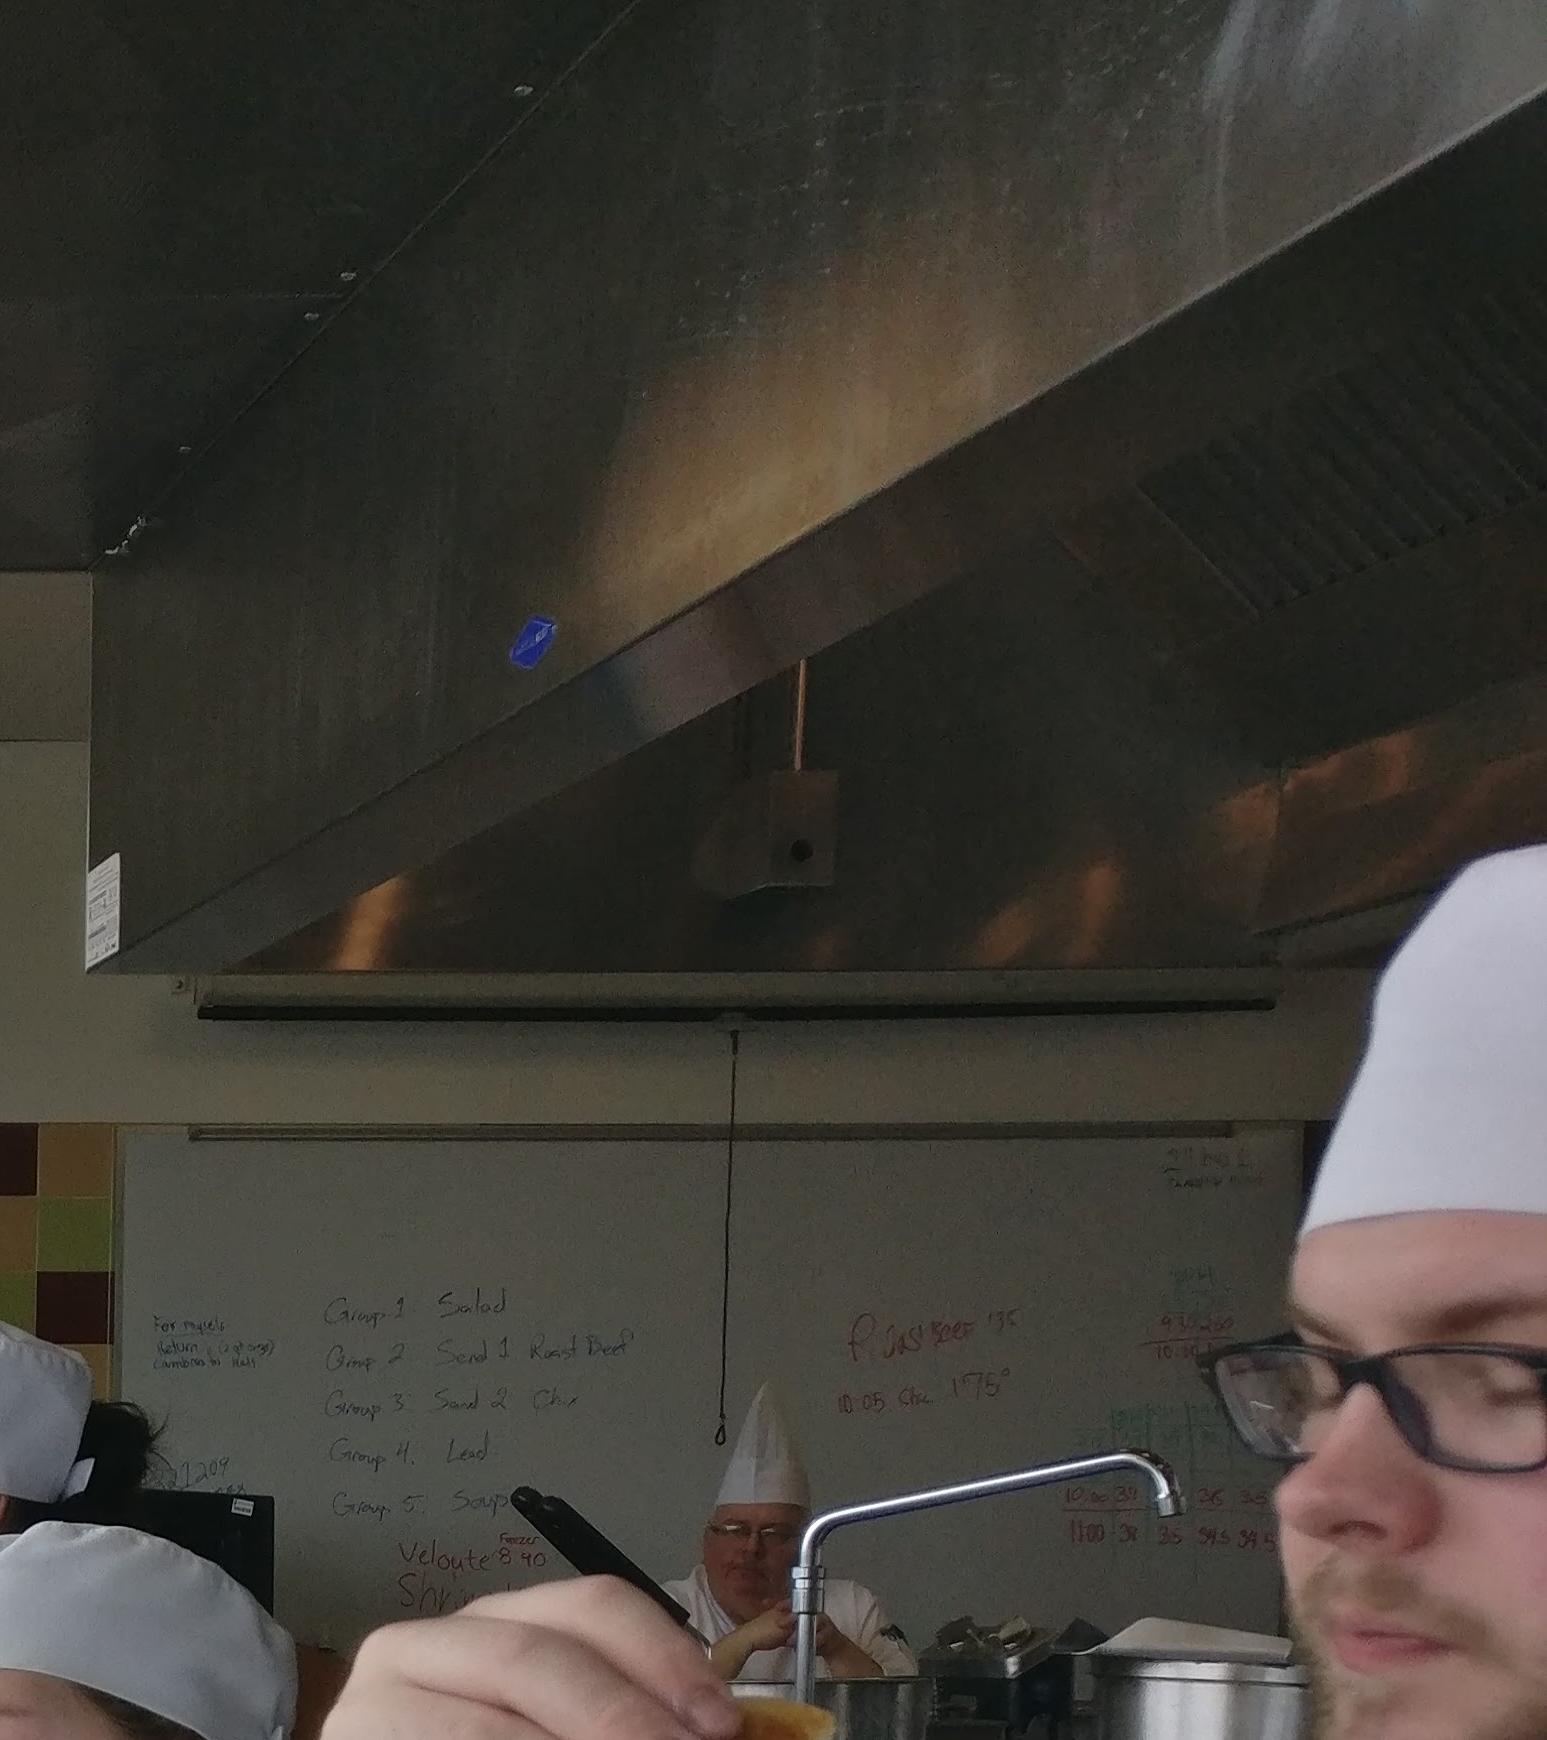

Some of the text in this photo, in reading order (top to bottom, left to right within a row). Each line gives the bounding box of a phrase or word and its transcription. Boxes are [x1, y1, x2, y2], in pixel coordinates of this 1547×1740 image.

[323, 1297, 385, 1328] Group
[437, 1287, 508, 1320] Salad
[325, 1344, 377, 1373] Group
[529, 1331, 577, 1360] Roast
[586, 1327, 635, 1358] Beef
[324, 1389, 382, 1422] Group
[328, 1437, 387, 1472] Group
[332, 1491, 392, 1523] Group
[452, 1488, 510, 1518] Soup
[398, 1539, 492, 1572] Veloute
